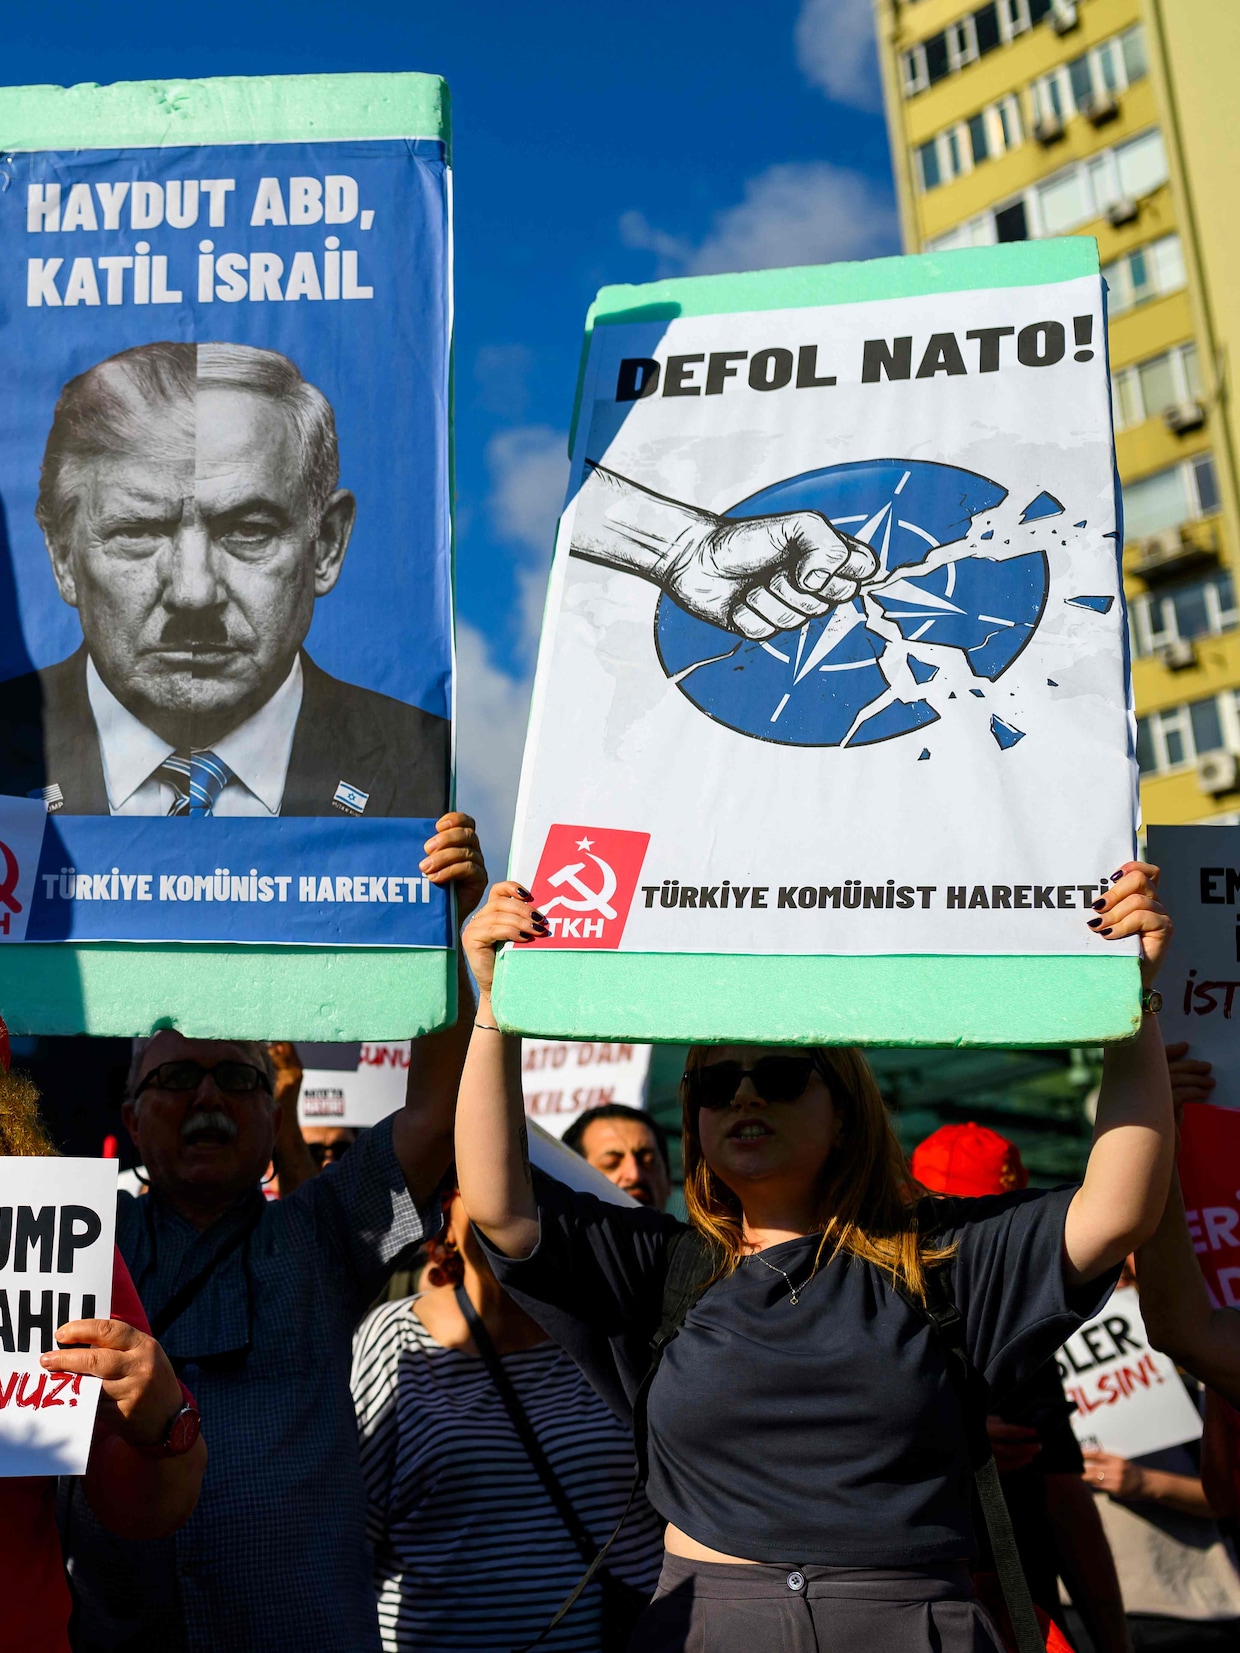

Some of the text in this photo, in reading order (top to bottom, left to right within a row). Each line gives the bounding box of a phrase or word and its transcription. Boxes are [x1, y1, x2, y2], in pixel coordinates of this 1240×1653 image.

[26, 174, 376, 233] HAYDUT ABD,
[26, 235, 374, 308] KATİL İSRAİL
[615, 314, 1095, 403] DEFOL NATO!
[42, 867, 431, 904] TÜRKİYE KOMÜNİST HAREKETİ
[641, 879, 768, 909] TÜRKİYE
[777, 878, 938, 909] KOMÜNİST
[546, 917, 605, 939] TKH
